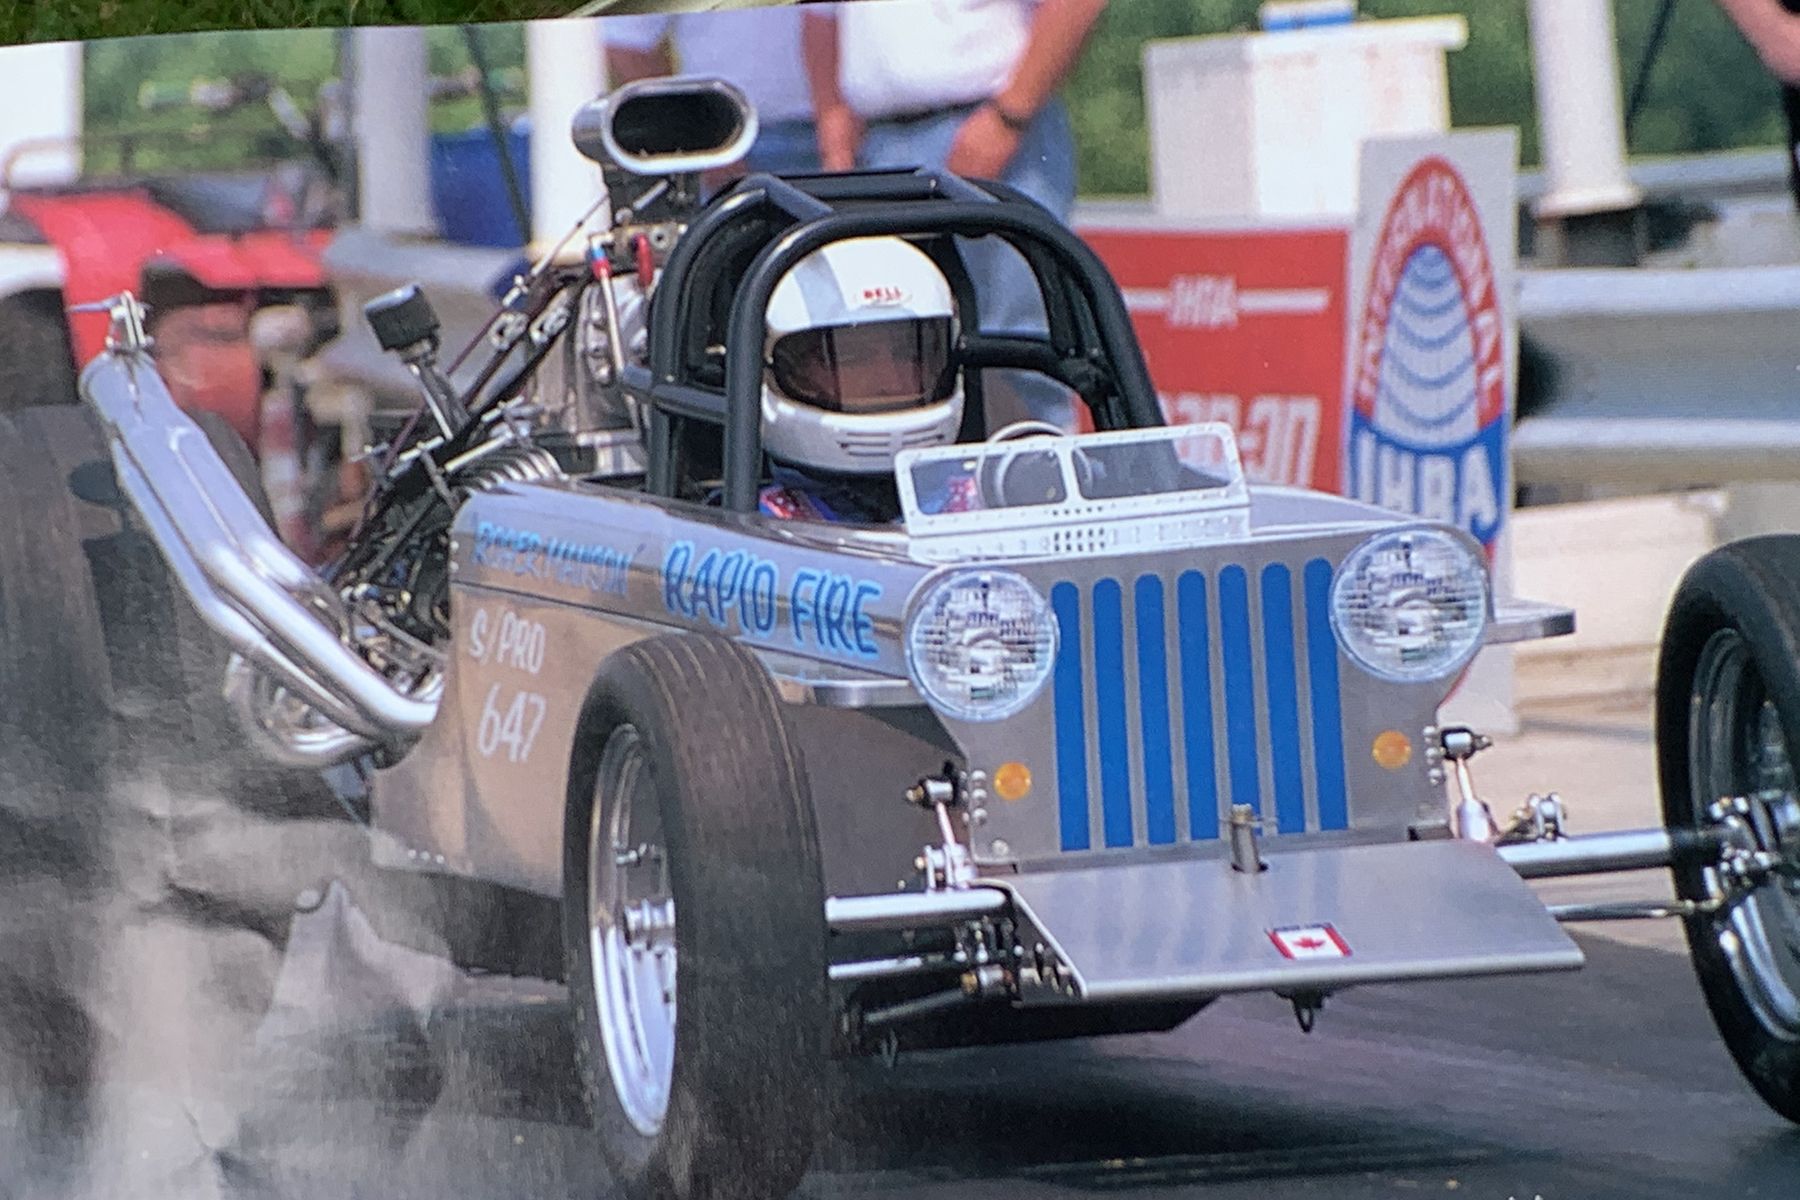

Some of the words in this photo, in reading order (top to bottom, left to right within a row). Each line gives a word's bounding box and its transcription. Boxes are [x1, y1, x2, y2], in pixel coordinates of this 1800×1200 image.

[1356, 428, 1499, 530] IHRA
[469, 608, 546, 675] S/PRO
[662, 540, 780, 638] RAPID
[789, 566, 882, 661] FIRE
[477, 685, 547, 761] 647
